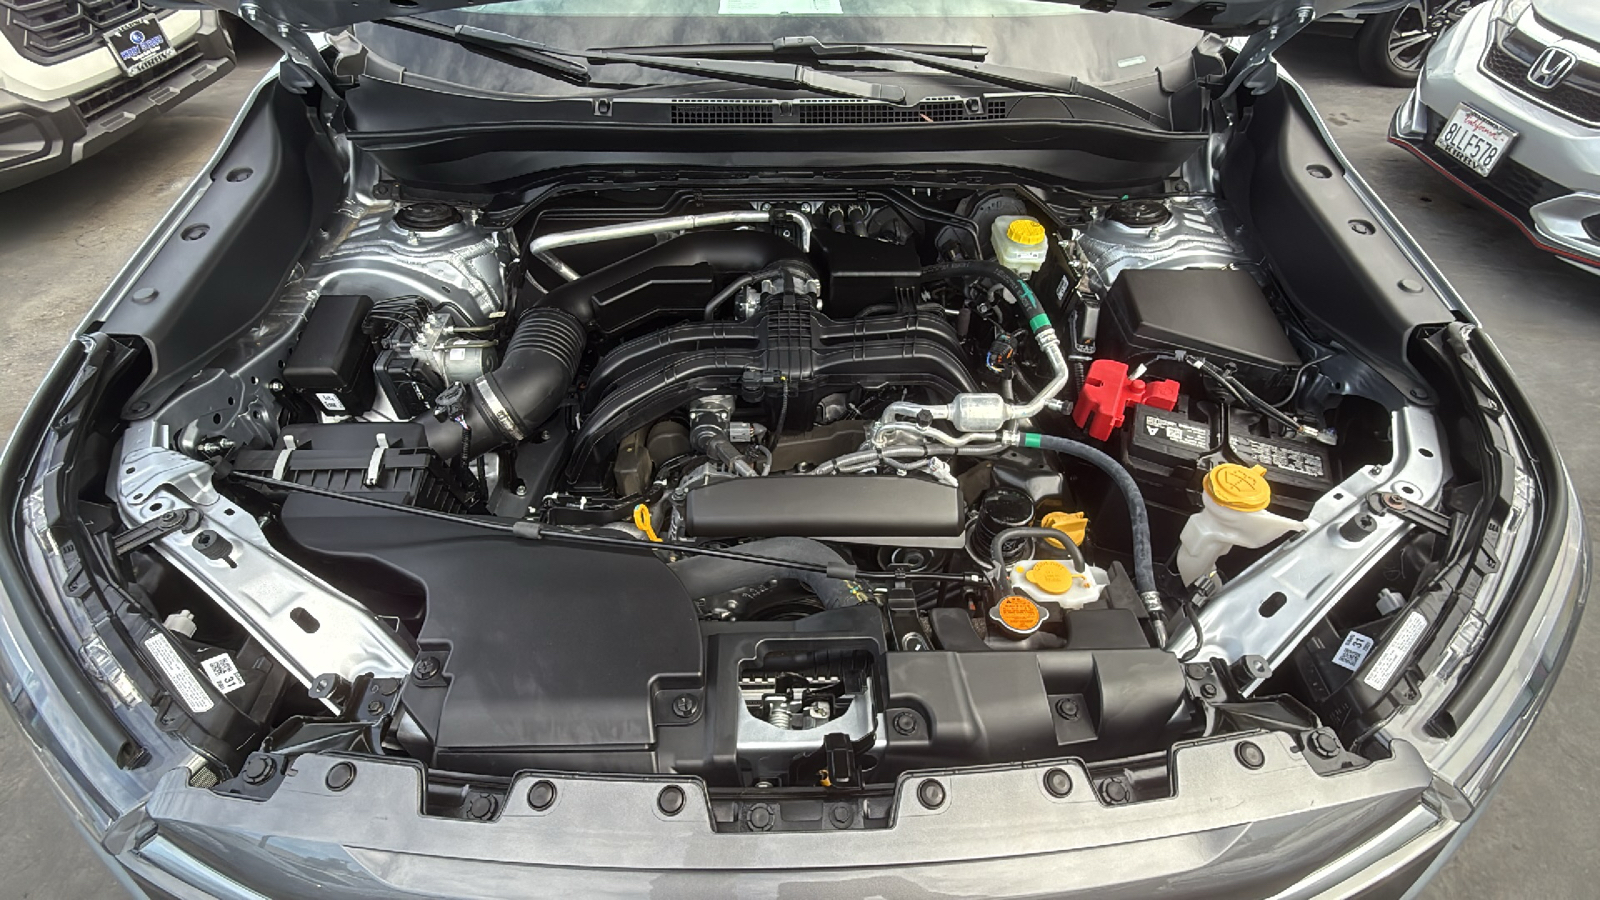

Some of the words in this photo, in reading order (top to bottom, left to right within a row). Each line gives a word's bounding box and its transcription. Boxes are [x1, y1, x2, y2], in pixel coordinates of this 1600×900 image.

[1444, 123, 1498, 166] 8LLF578
[1444, 144, 1480, 169] KIRBY
[1352, 637, 1365, 649] 31
[224, 676, 237, 688] 31
